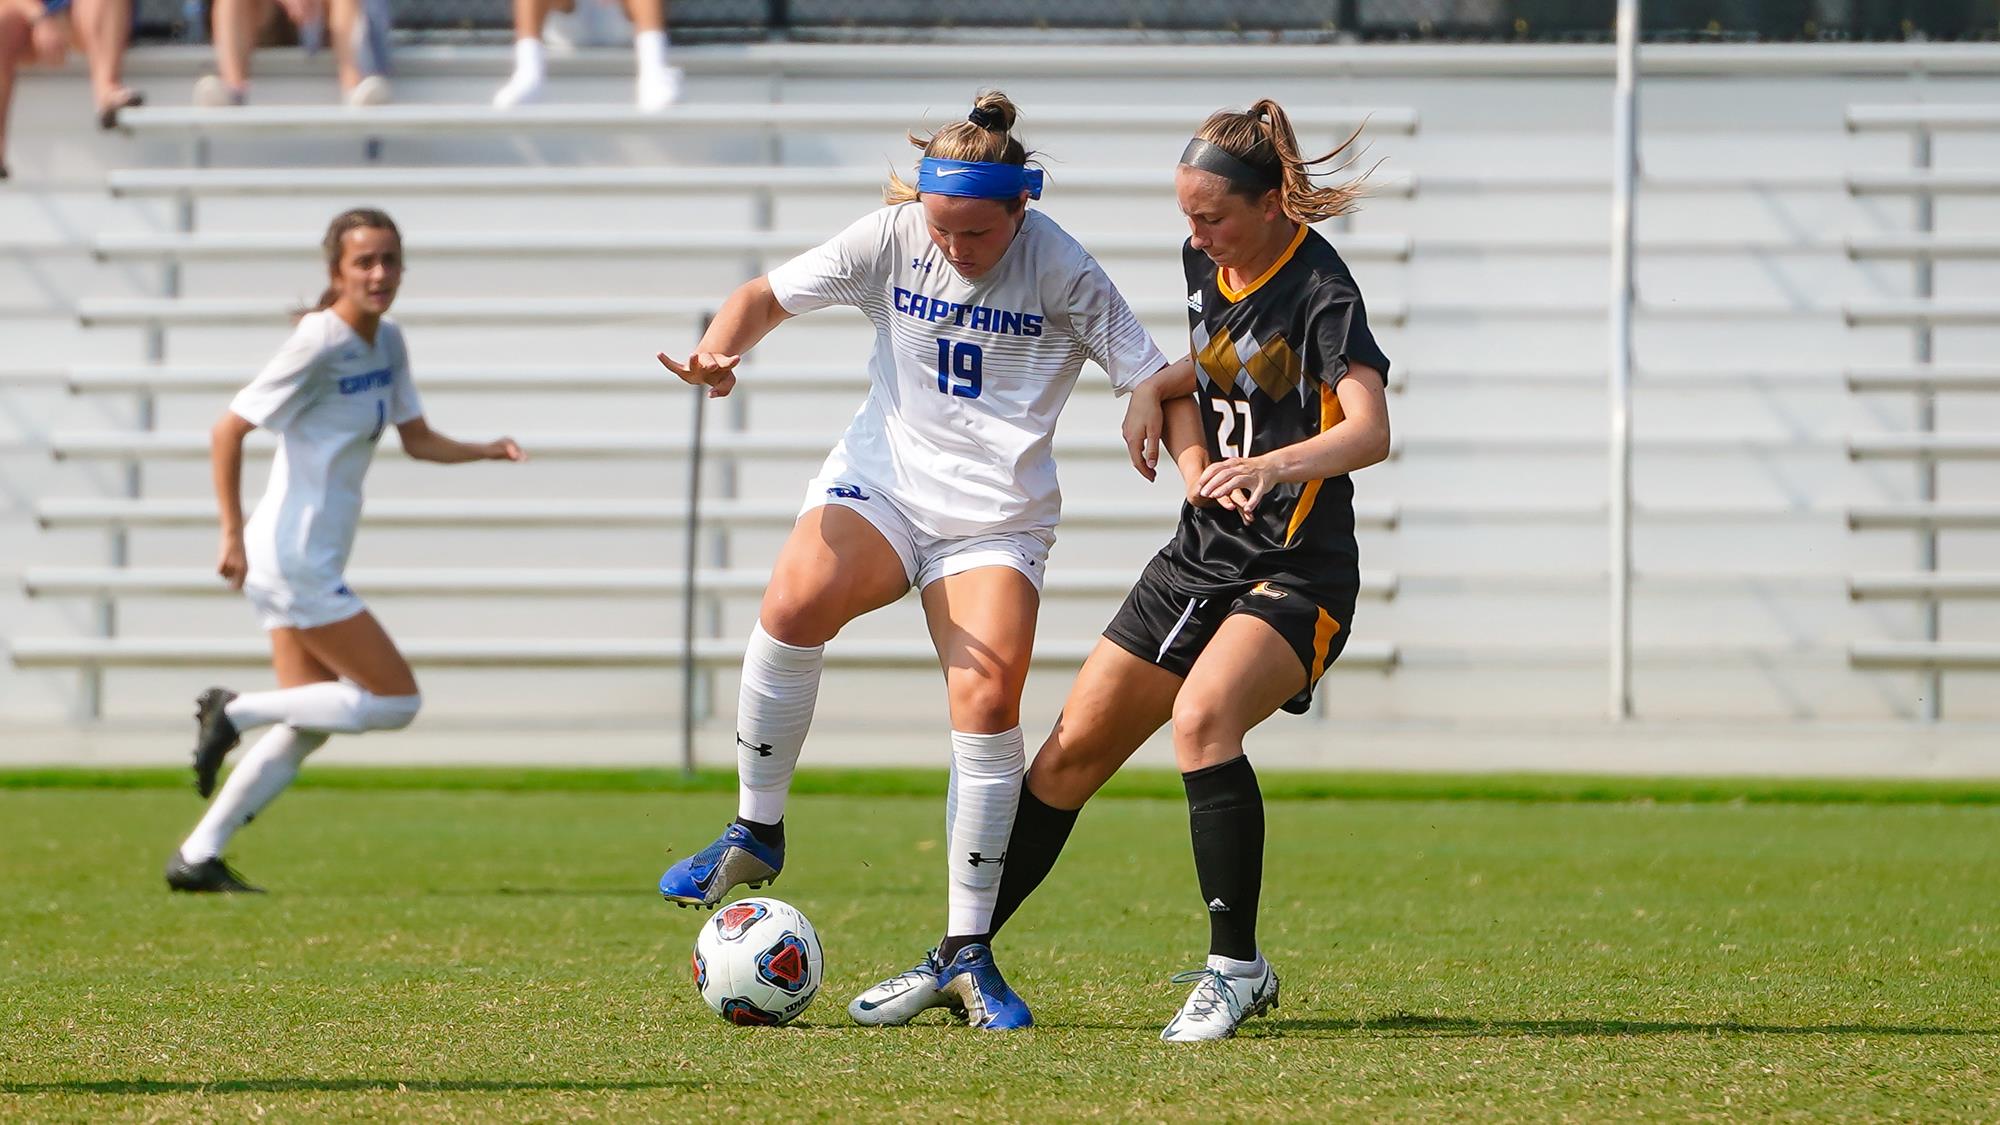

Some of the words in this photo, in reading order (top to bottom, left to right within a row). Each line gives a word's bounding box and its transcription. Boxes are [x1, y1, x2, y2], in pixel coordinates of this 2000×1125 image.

[893, 286, 1044, 337] CAPTAINS
[936, 337, 983, 400] 19
[1211, 398, 1253, 459] 27
